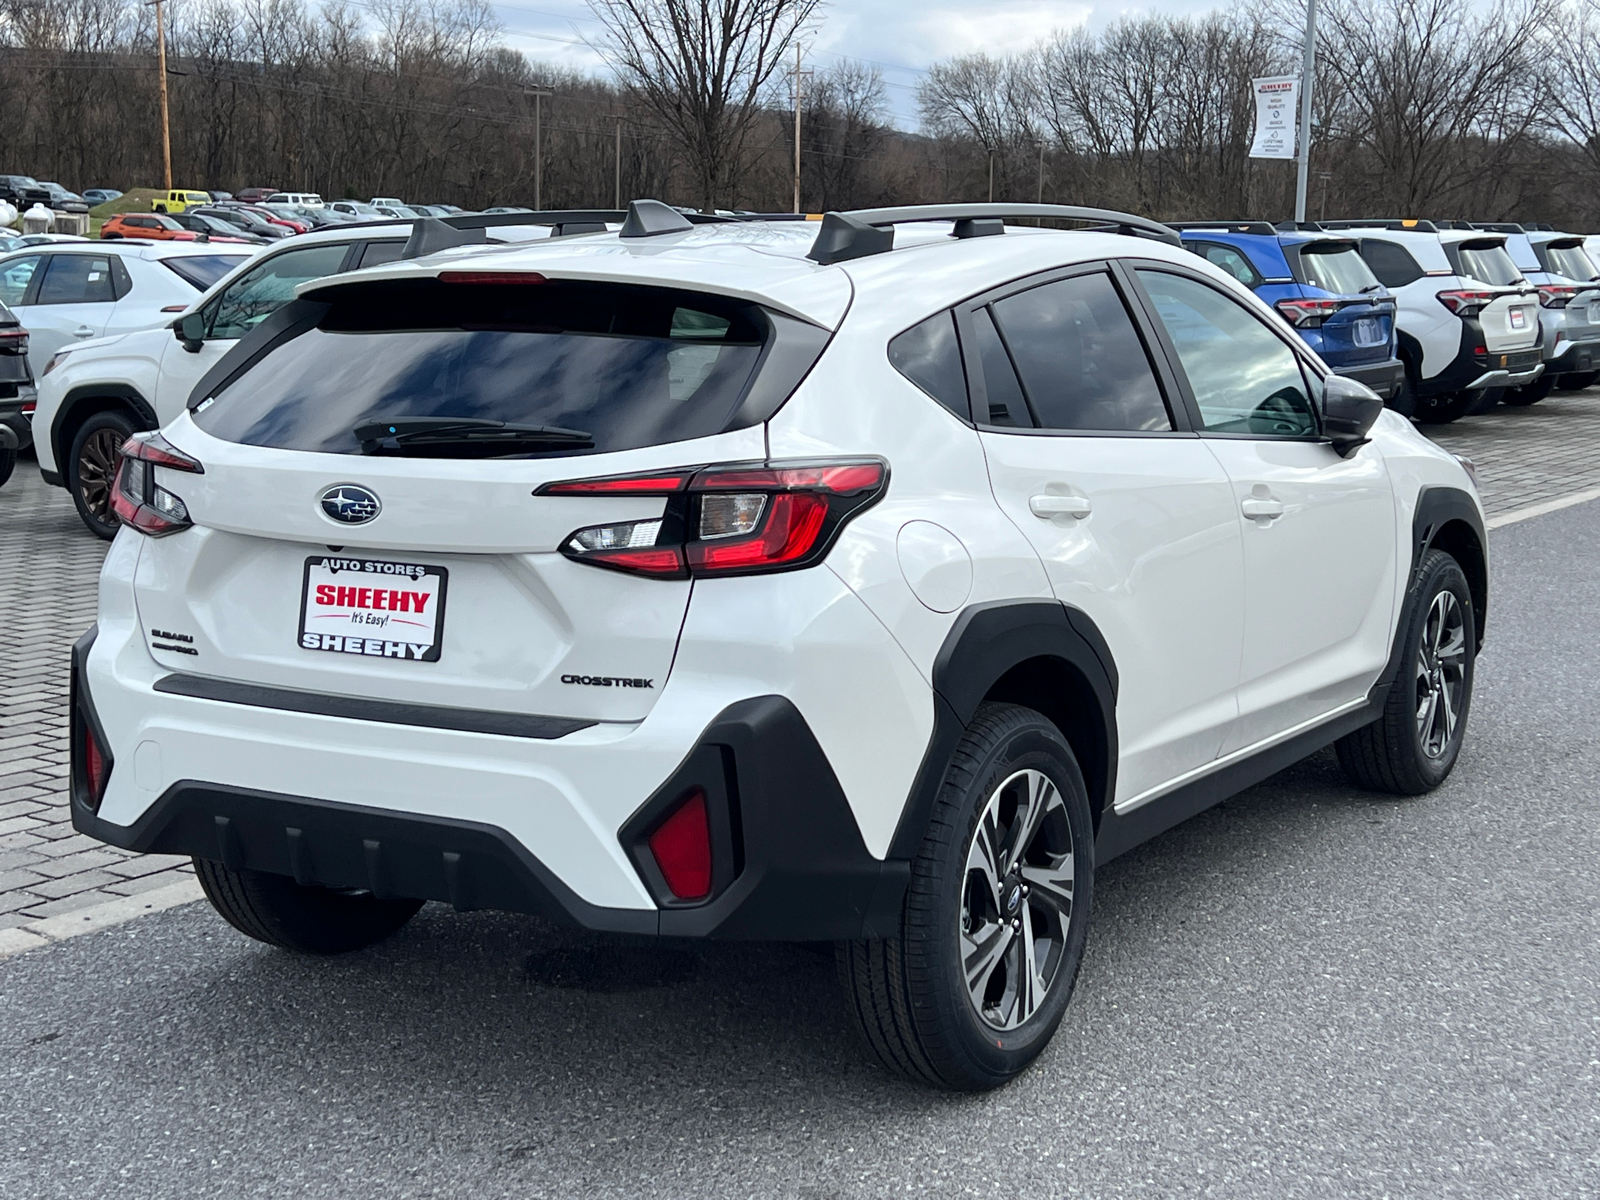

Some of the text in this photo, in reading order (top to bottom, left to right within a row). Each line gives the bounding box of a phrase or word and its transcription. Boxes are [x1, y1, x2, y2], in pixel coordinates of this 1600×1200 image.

[321, 558, 425, 577] AUTO STORES
[315, 584, 431, 614] SHEEHY
[351, 611, 390, 629] It's Easy!
[151, 629, 193, 643] SUBARU
[302, 633, 431, 660] SHEEHY
[560, 674, 654, 689] CROSSTREK
